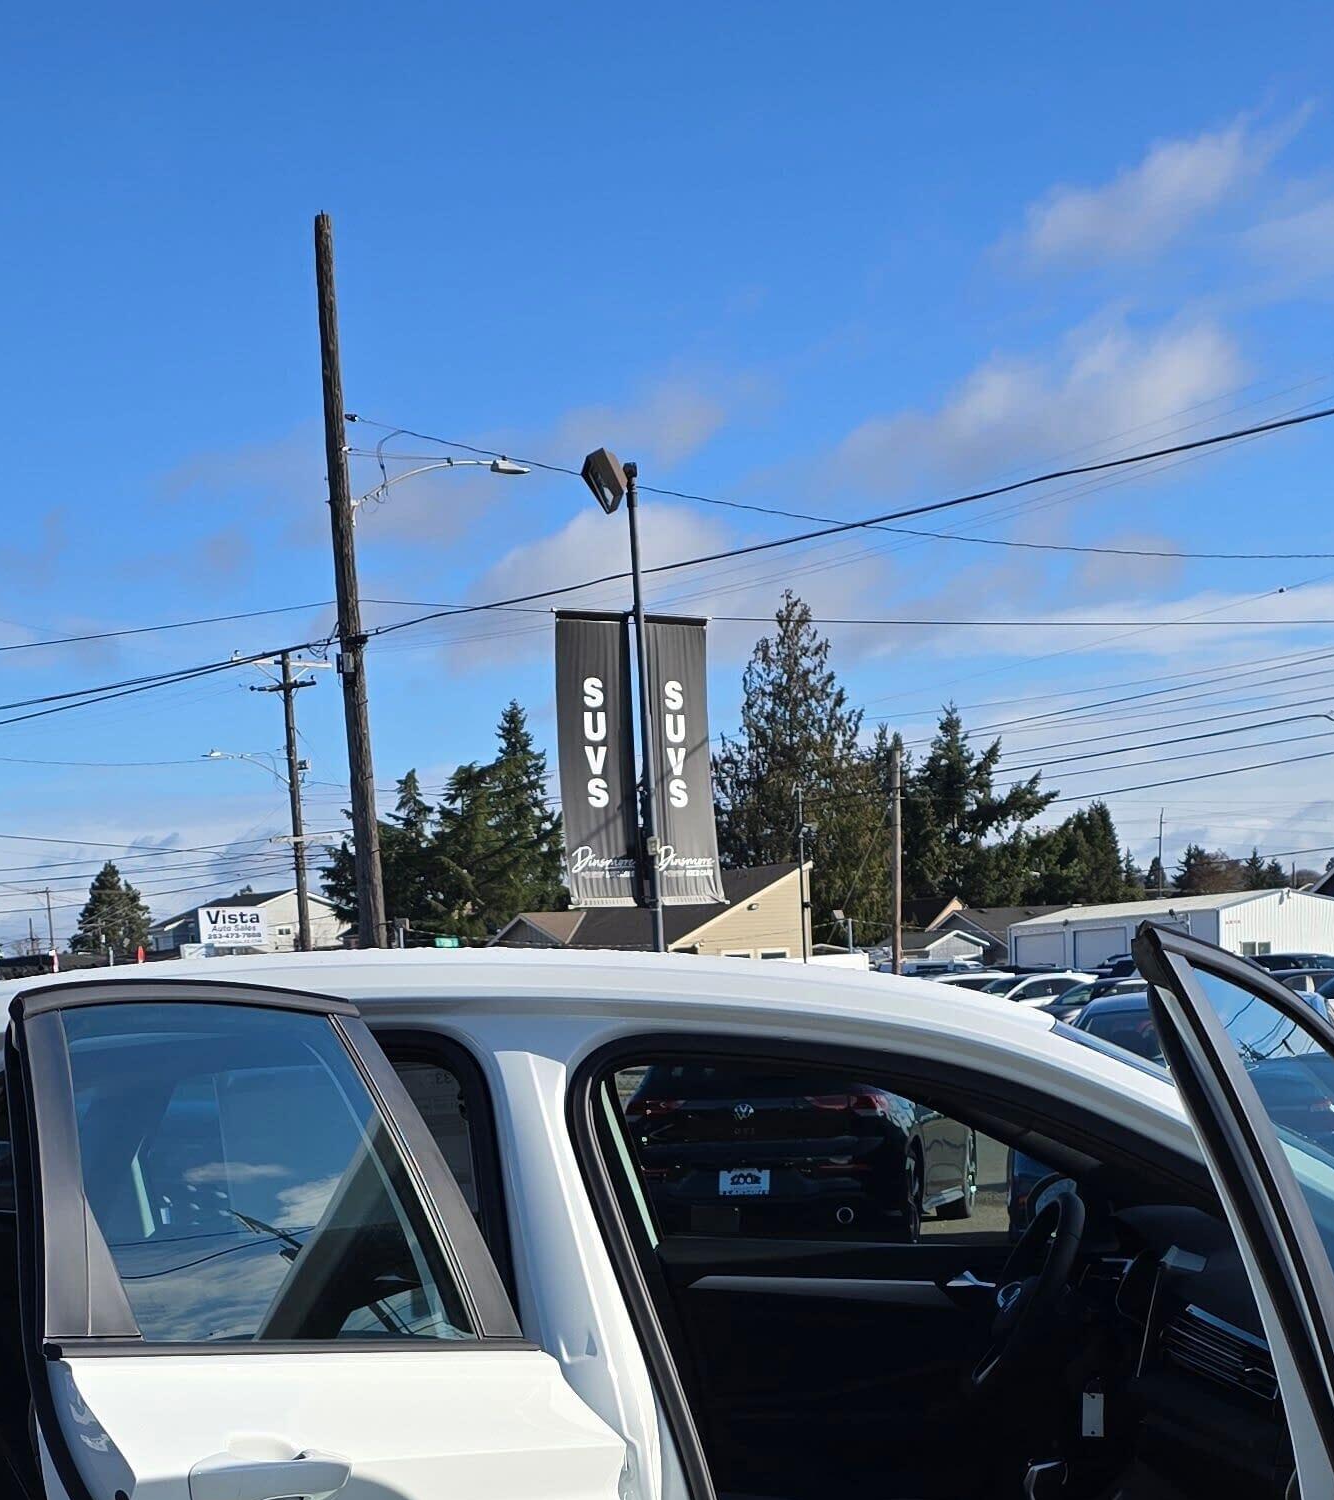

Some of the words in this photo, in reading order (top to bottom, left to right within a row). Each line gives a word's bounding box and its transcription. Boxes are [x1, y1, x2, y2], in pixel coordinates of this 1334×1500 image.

[583, 675, 610, 808] SUVS
[664, 679, 689, 809] SUVS
[657, 845, 715, 872] Dinsmore
[206, 910, 260, 924] Vista
[234, 924, 256, 932] Sales
